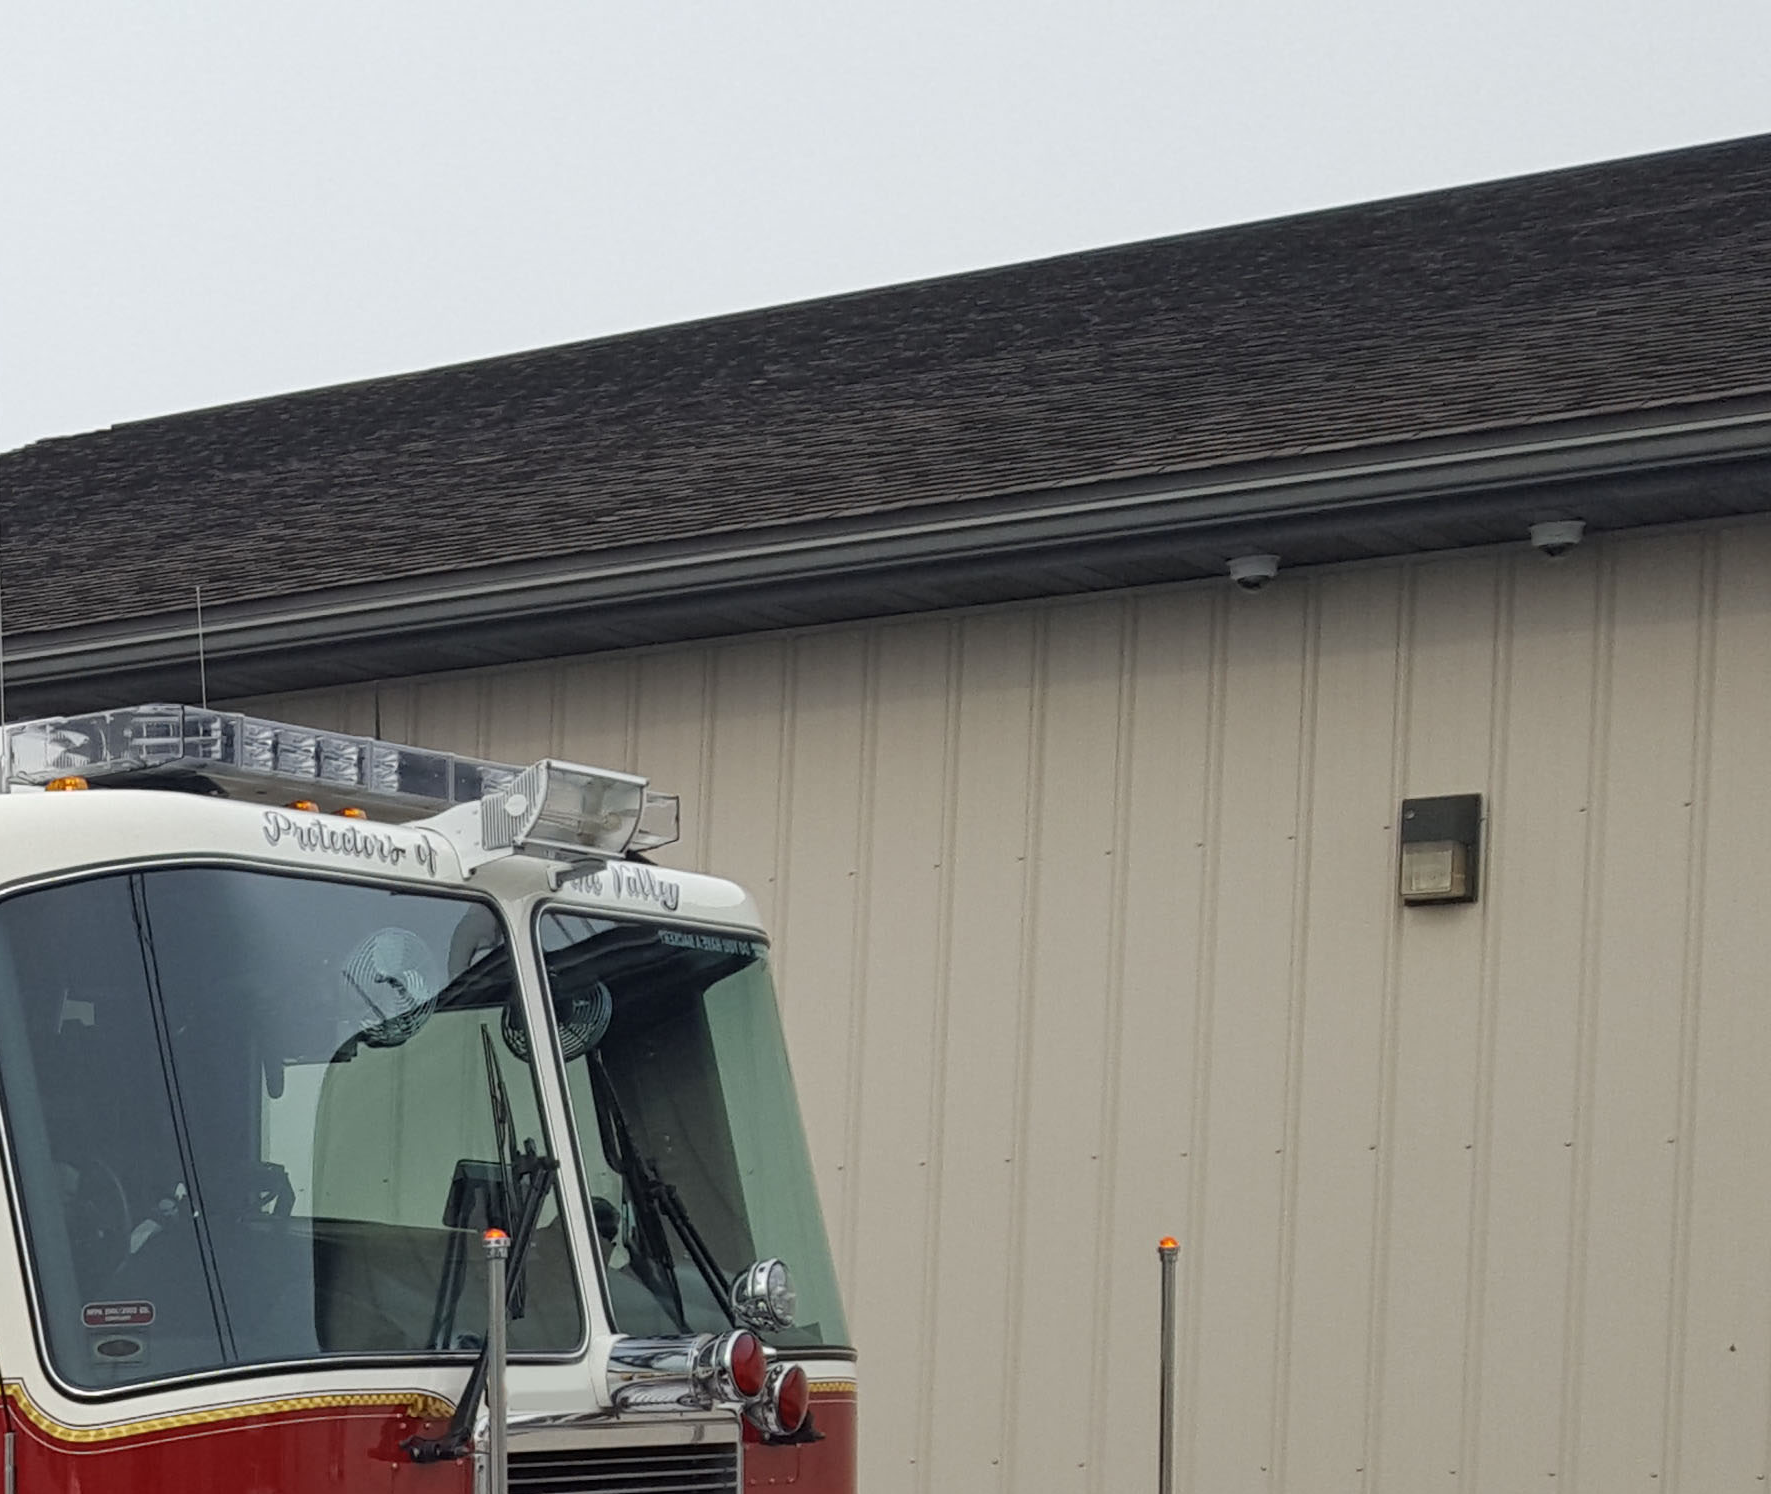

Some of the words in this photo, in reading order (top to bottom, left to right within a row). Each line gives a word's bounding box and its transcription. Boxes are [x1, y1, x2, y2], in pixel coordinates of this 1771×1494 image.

[261, 810, 408, 866] Protectors
[414, 833, 438, 879] of
[610, 863, 681, 913] Valley
